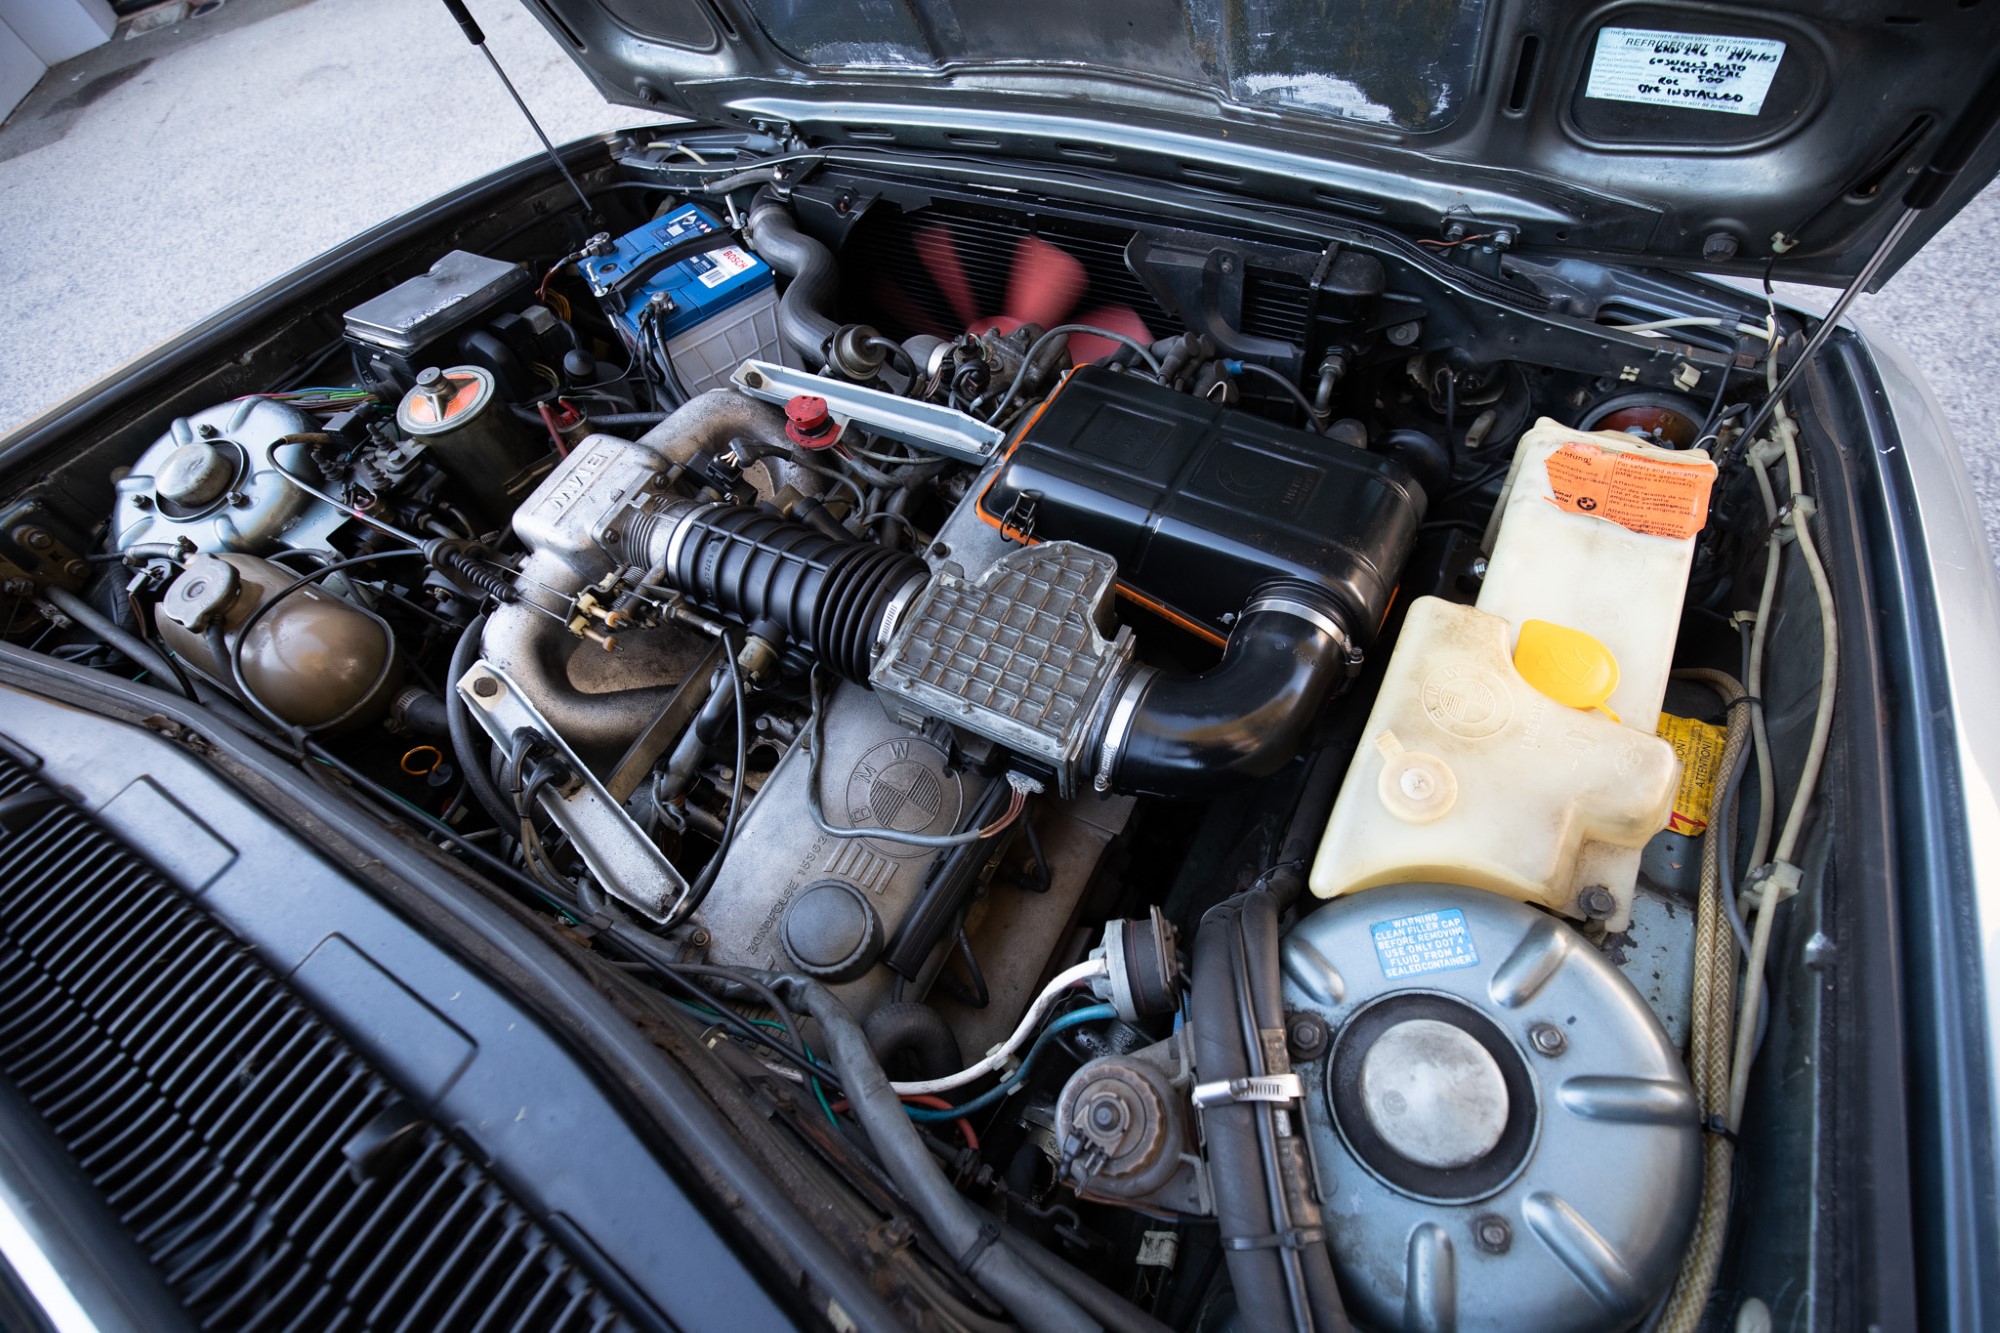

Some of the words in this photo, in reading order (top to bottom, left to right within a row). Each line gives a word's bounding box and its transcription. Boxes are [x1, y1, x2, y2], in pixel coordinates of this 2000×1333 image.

[1625, 37, 1710, 51] REFRIGERANT
[1713, 62, 1747, 72] AUTO
[723, 250, 748, 270] BOSCH
[1630, 463, 1650, 472] safety
[1666, 469, 1700, 479] warranty
[852, 741, 910, 824] BMW
[1375, 928, 1406, 941] CLEAN
[1407, 922, 1439, 936] FILLER
[1441, 917, 1461, 929] CAP
[1392, 913, 1439, 929] WARNING
[1378, 935, 1416, 950] BEFORE
[1417, 926, 1465, 942] REMOVING
[1384, 947, 1406, 958] USE
[1408, 941, 1433, 954] ONLY
[1435, 937, 1455, 949] DOT
[1390, 954, 1420, 967] FLUID
[1424, 948, 1453, 961] FROM
[1456, 946, 1464, 955] A
